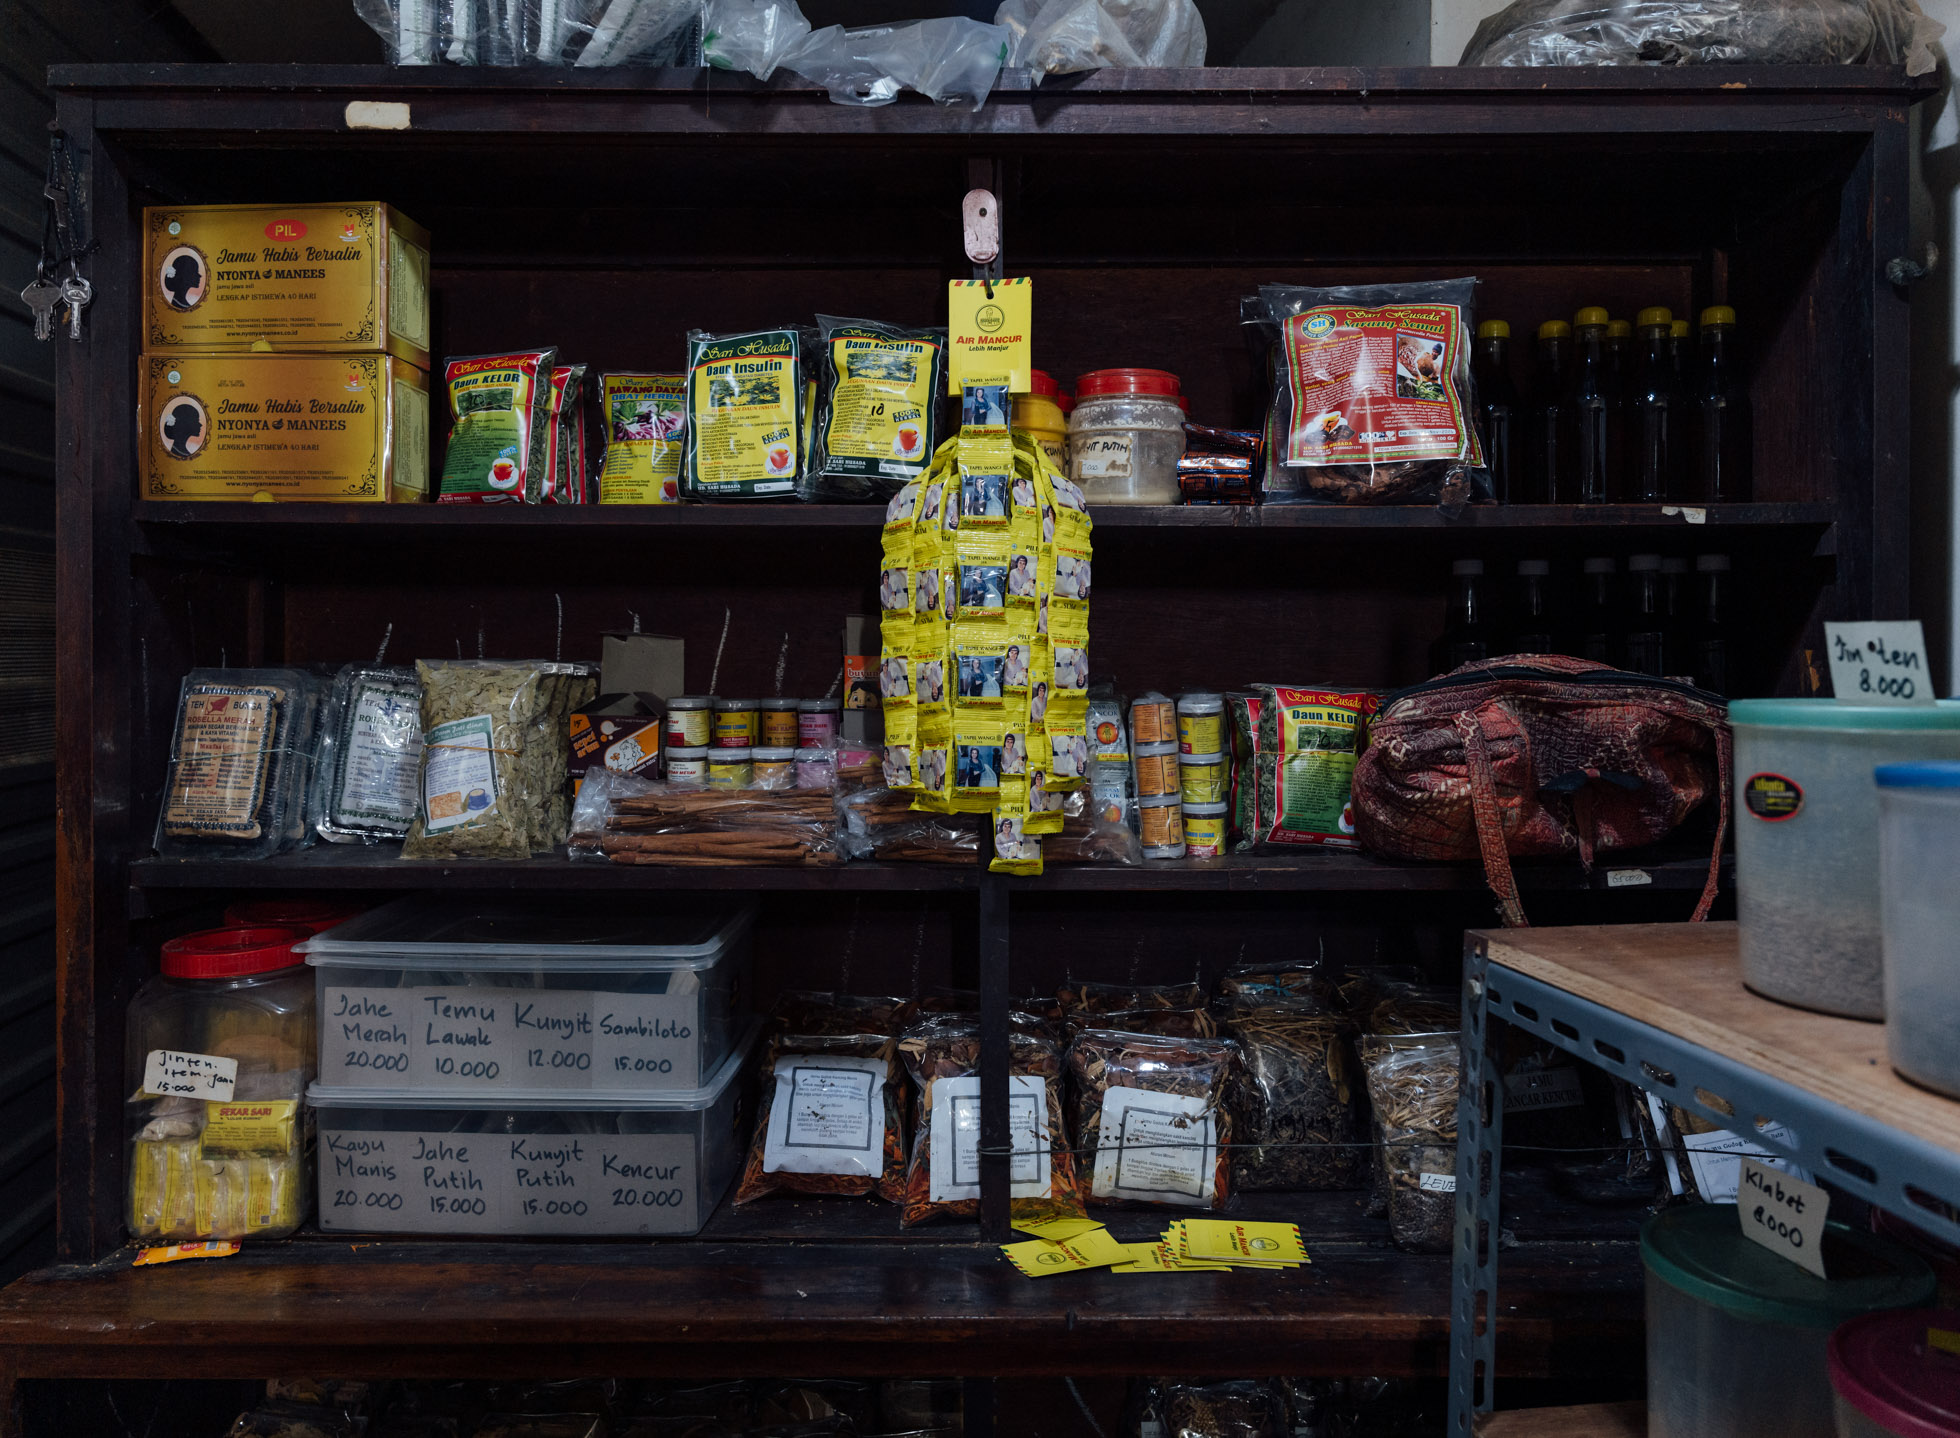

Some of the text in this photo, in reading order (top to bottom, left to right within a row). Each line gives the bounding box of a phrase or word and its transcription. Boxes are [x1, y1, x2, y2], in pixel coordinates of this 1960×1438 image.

[275, 224, 297, 237] PIL
[216, 246, 363, 265] Jamu Habis Bersalin
[217, 268, 326, 281] NYONYA MANEES
[251, 293, 286, 301] ISTIMEWA
[298, 292, 317, 300] HARI
[1346, 310, 1441, 321] Sari Husada
[1310, 320, 1326, 328] SH
[1341, 318, 1445, 334] Sarang Semut
[845, 340, 872, 349] Daun
[956, 334, 1022, 344] AIR MANCUR
[700, 338, 792, 360] Sari Husada
[706, 358, 782, 376] Daun Insulin
[454, 373, 520, 390] Daun KELOR
[612, 393, 640, 401] OBAT
[217, 398, 366, 415] Jamu Habis Bersalin
[871, 403, 885, 416] 10
[217, 419, 346, 431] NYONYA MANEES
[1860, 668, 1914, 699] 8.000
[1286, 690, 1315, 703] Sari
[190, 700, 205, 709] TEH
[1292, 710, 1323, 720] Daun
[334, 994, 691, 1039] Jahe Temu Kunyit Sambiloto
[343, 1023, 407, 1046] Merah
[345, 1048, 673, 1080] 20.000 10.000 12.000 15.000
[157, 1081, 196, 1093] 15.000
[1504, 1092, 1541, 1108] ANCAR
[219, 1107, 272, 1116] SEKAR SARI
[327, 1134, 681, 1181] Kayu Jahe Kunyit Kencur
[335, 1155, 575, 1192] Manis Putih Putih
[1420, 1175, 1456, 1191] LEVE
[334, 1188, 683, 1216] 20.000 15.000 15.000 20.000
